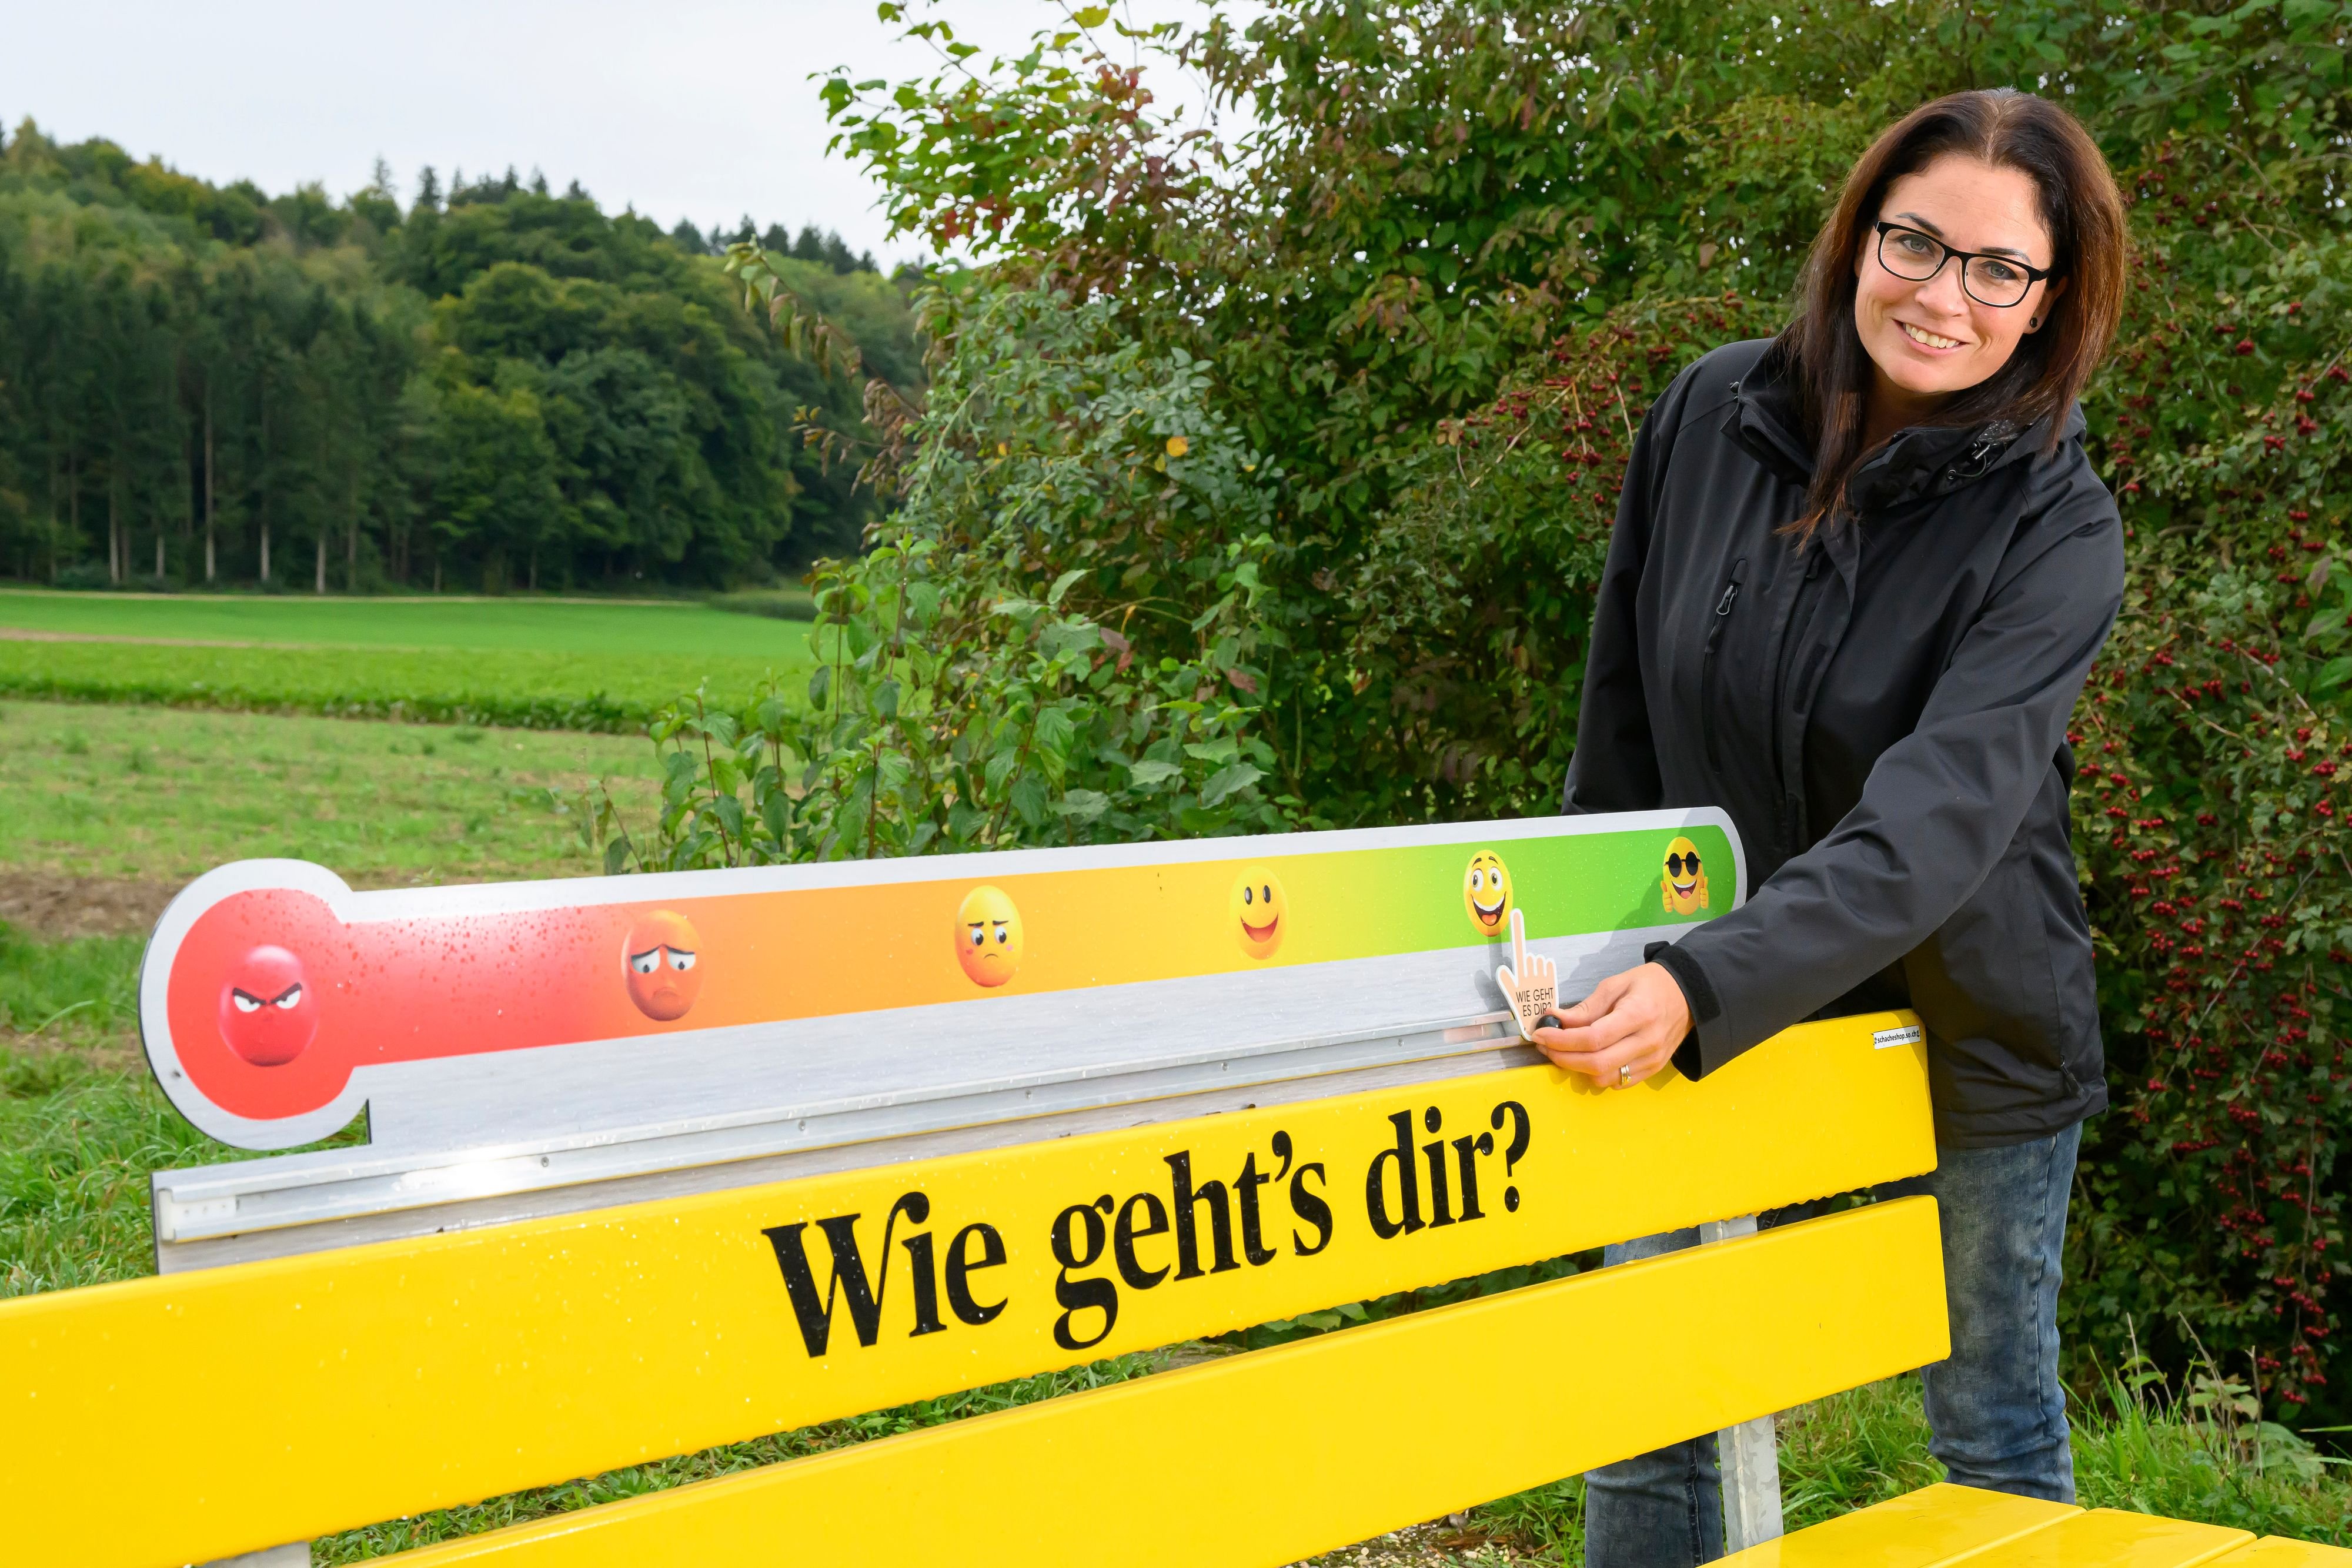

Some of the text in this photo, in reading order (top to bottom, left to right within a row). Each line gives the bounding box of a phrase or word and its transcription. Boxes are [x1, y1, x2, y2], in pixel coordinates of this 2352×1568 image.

[1516, 988, 1553, 1003] WIE GEHT
[1522, 1004, 1532, 1017] ES
[761, 1101, 1531, 1358] Wie geht’s dir?
